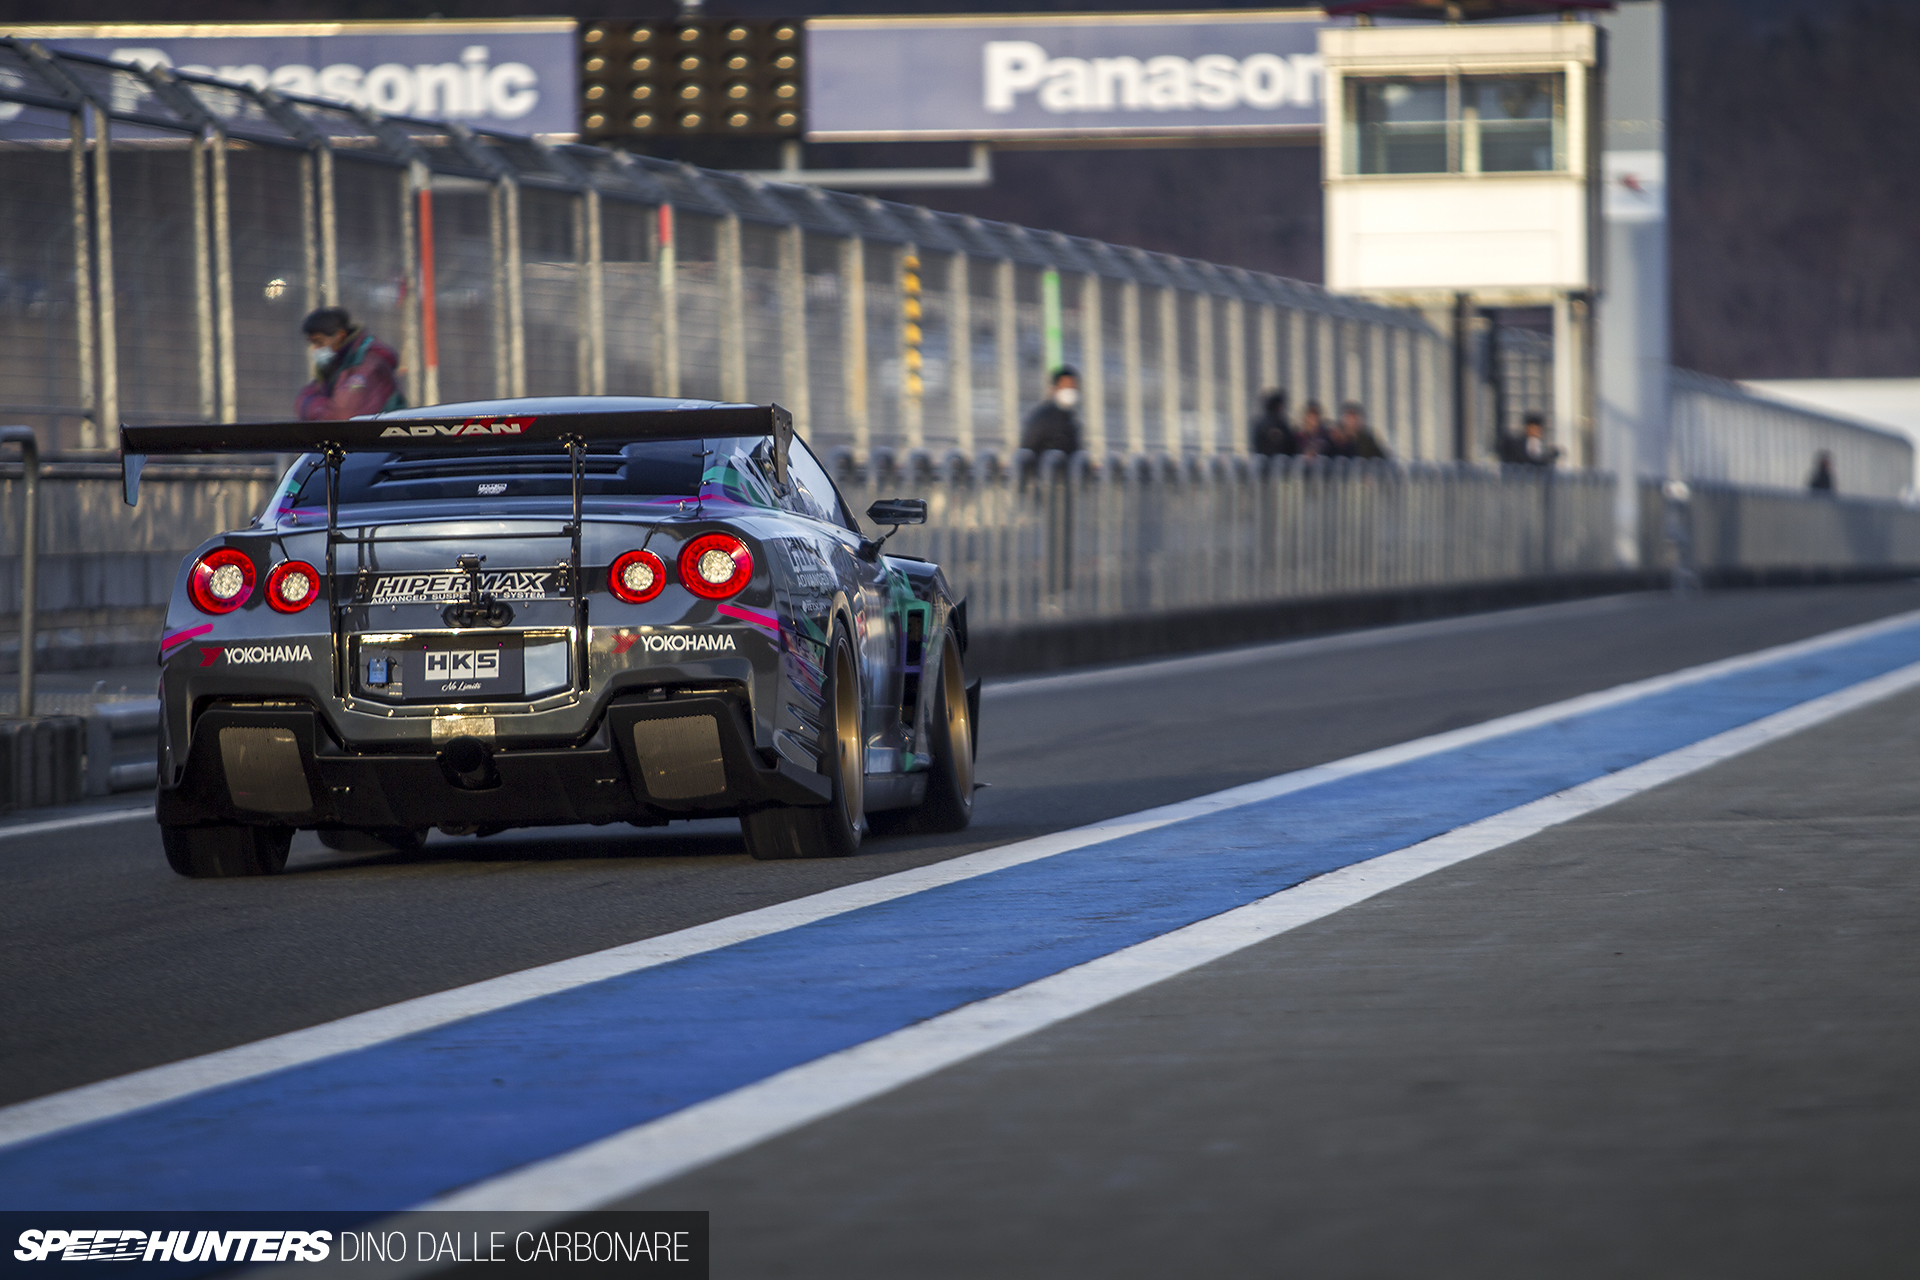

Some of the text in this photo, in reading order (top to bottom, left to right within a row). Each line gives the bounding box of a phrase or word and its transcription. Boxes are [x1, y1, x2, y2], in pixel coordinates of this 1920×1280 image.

[380, 423, 522, 438] ADVAN
[372, 572, 552, 598] HIPERMAX
[371, 594, 427, 604] ADVANCED
[641, 634, 736, 652] YOKOHAMA
[224, 645, 312, 665] YOKOHAMA
[427, 652, 498, 674] HKS
